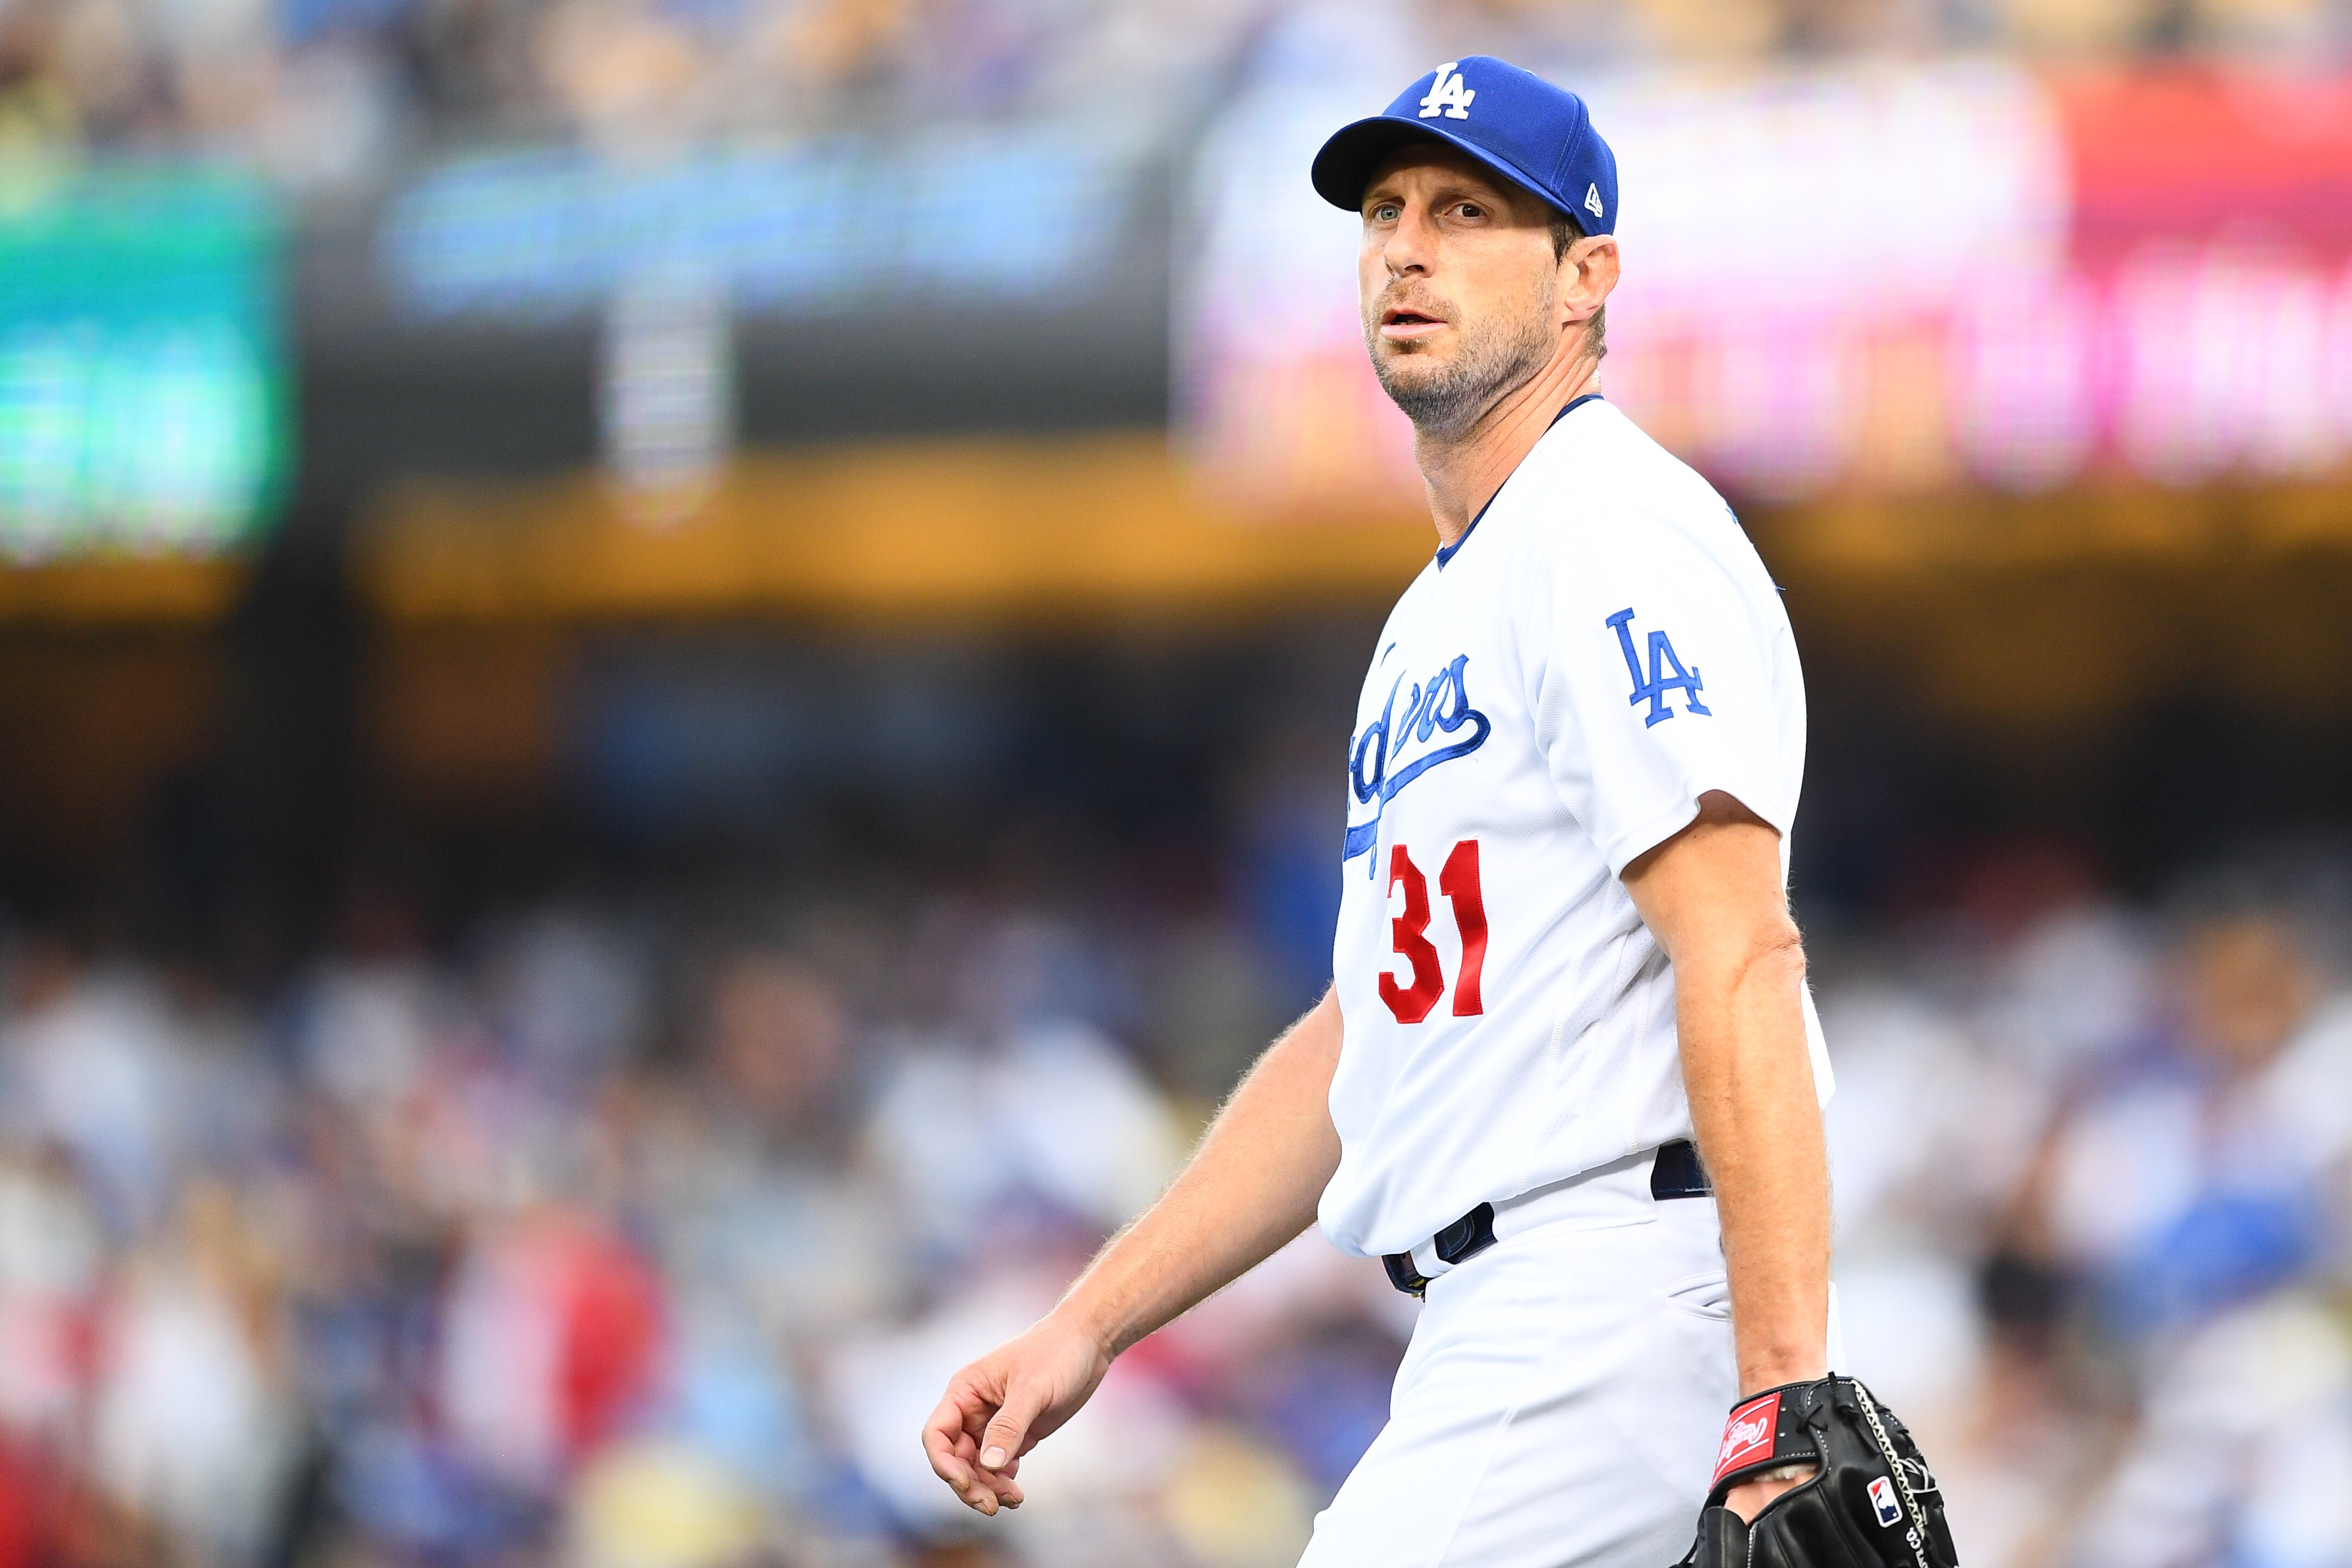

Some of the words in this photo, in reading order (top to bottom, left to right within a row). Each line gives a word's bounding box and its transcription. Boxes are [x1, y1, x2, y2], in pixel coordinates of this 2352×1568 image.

[1418, 62, 1475, 120] LA
[1349, 654, 1491, 805] ders
[1605, 607, 1712, 729] LA
[1379, 839, 1488, 1023] 31
